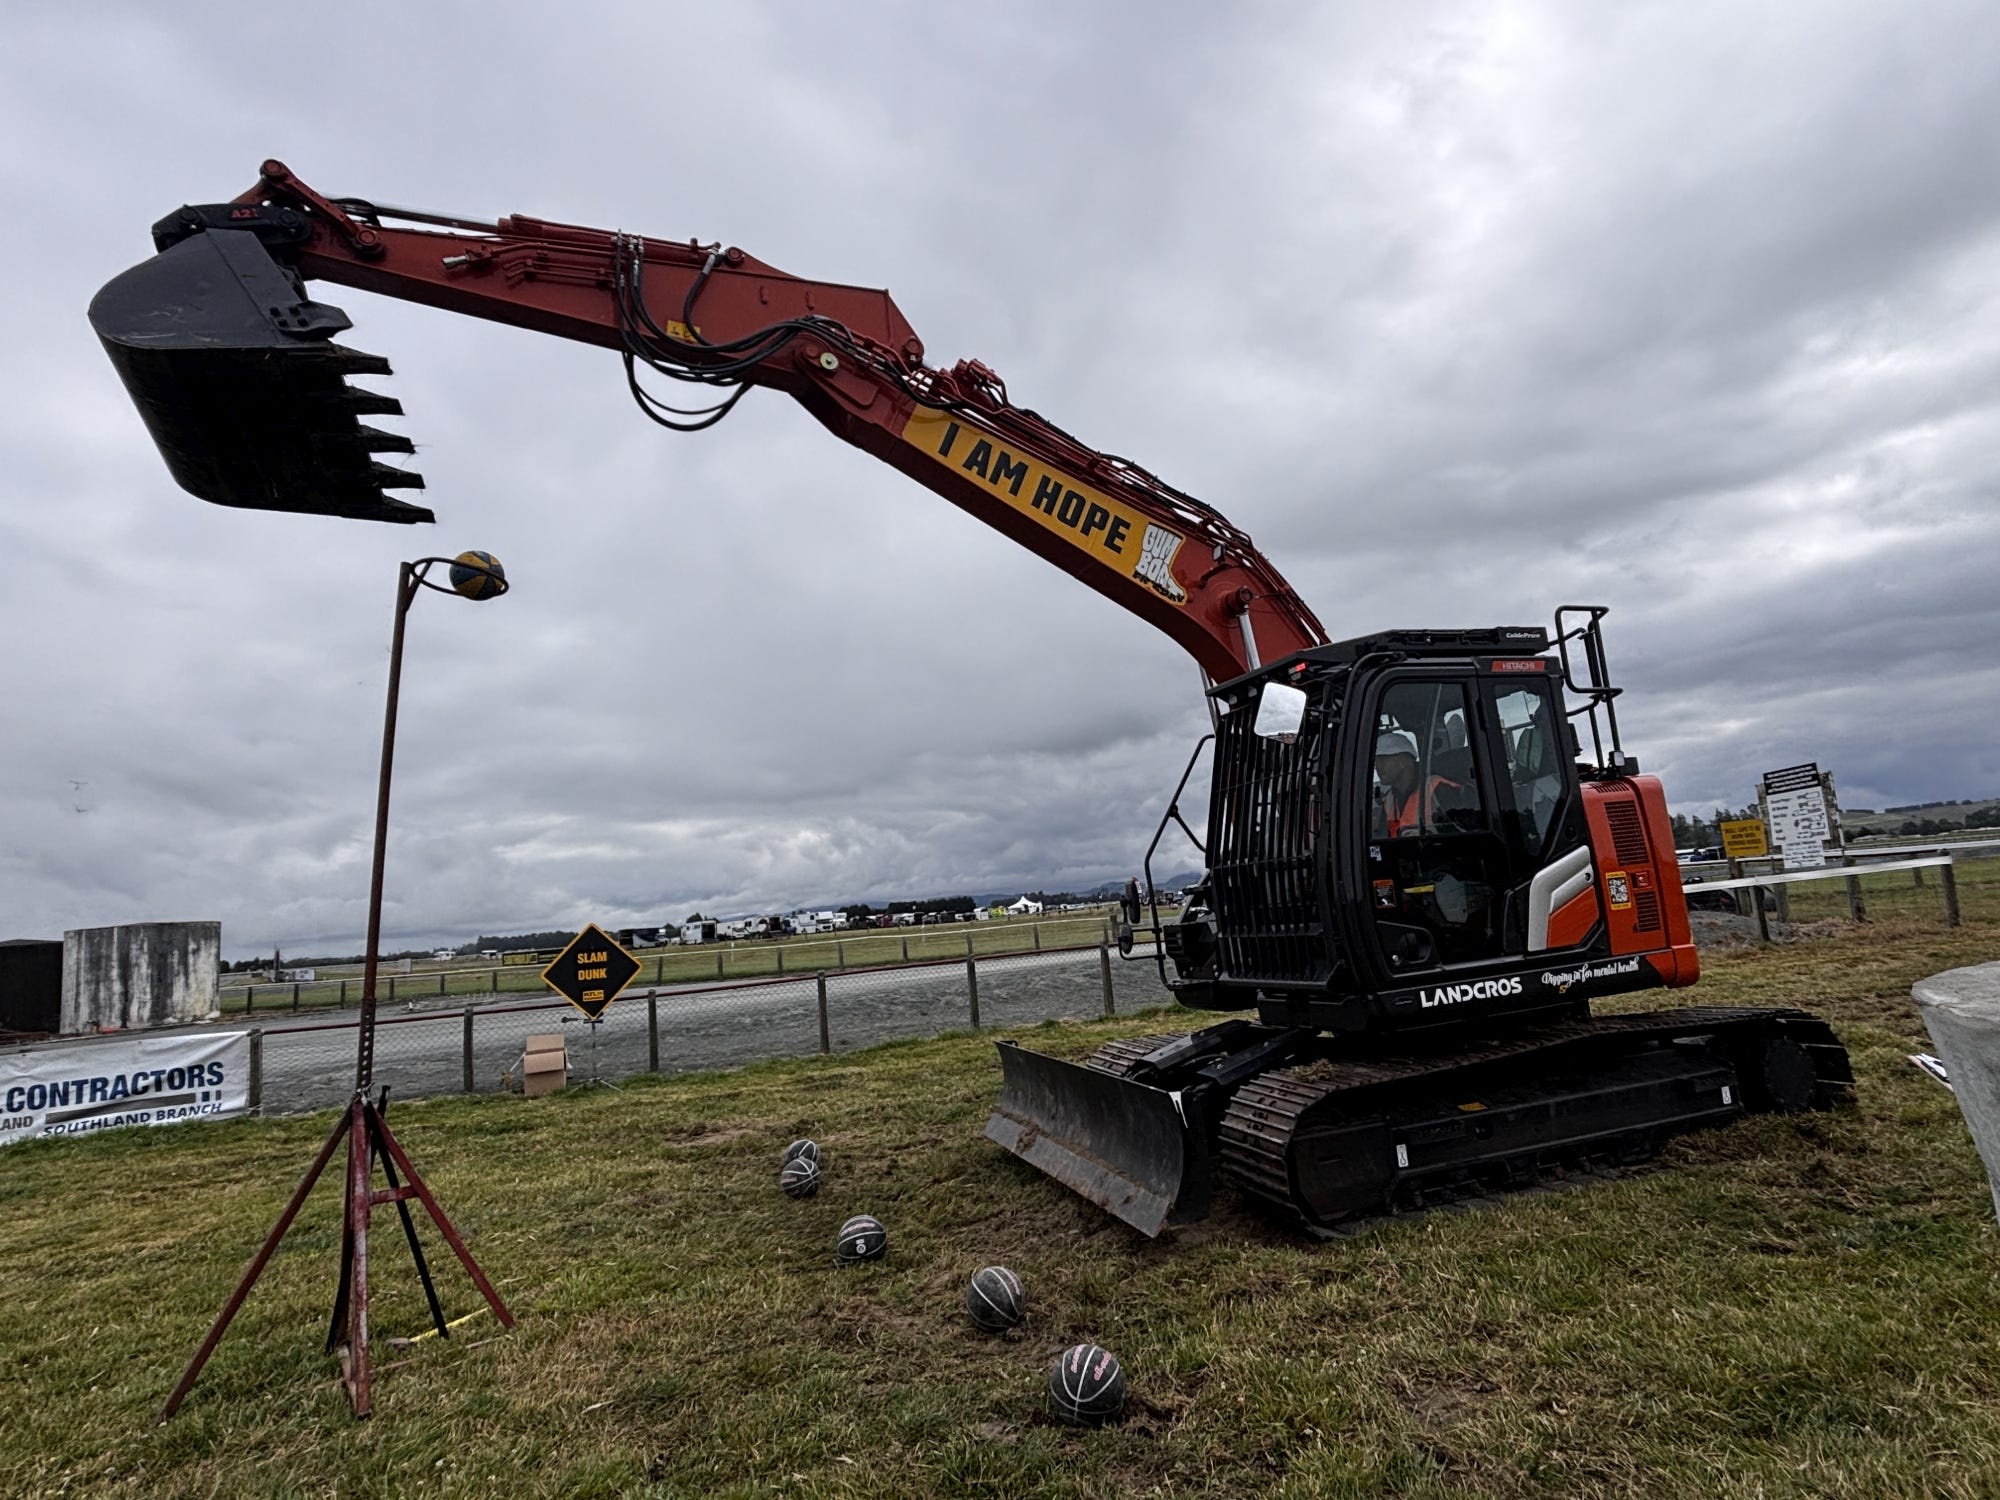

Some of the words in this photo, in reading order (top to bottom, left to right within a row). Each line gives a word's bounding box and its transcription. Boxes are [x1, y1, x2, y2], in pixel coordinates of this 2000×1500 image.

[938, 421, 960, 457] I
[962, 438, 1029, 497] AM
[1030, 474, 1131, 555] HOPE
[1502, 661, 1536, 670] HITACHI
[577, 951, 607, 964] SLAM
[1541, 972, 1576, 988] Digging
[1593, 962, 1617, 978] mental
[1618, 955, 1640, 974] health
[577, 968, 607, 981] DUNK
[1419, 977, 1523, 1008] LANDCROS
[7, 1061, 225, 1113] CONTRACTORS
[43, 1111, 151, 1137] SOUTHLAND
[156, 1103, 222, 1121] BRANCH
